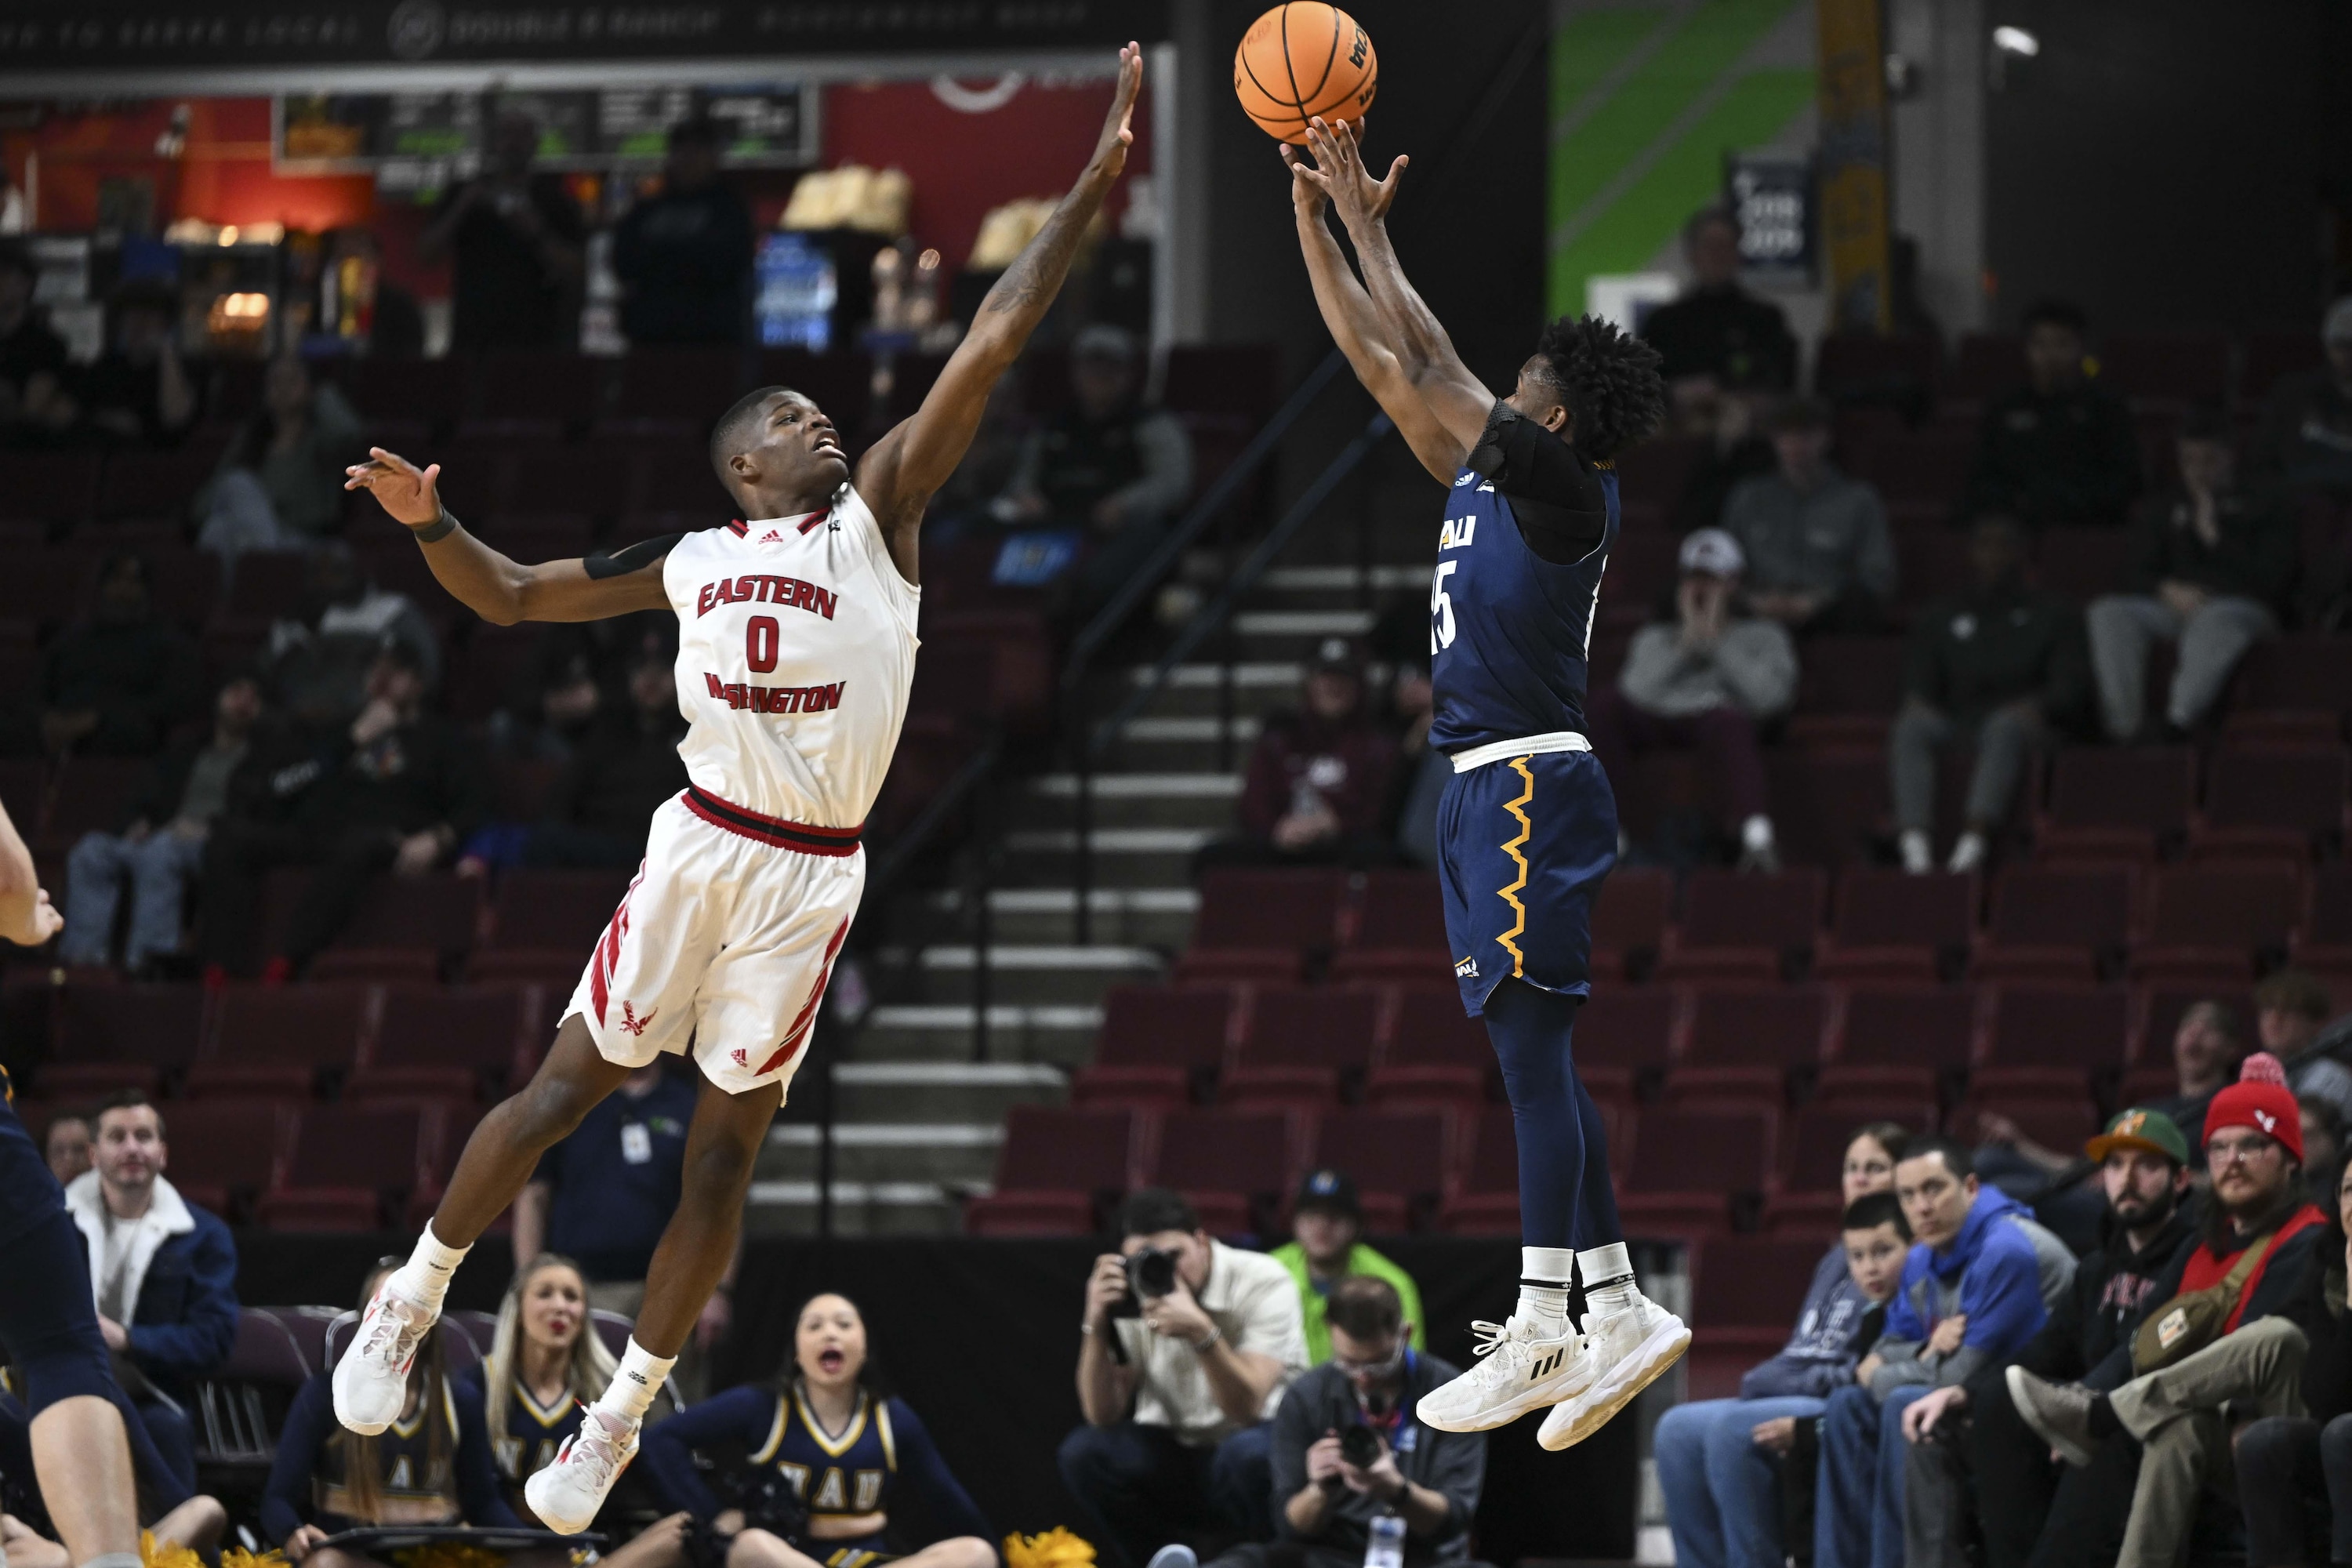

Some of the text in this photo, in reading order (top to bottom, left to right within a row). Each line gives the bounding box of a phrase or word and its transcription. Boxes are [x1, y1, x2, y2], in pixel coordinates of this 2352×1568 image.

[697, 575, 838, 621] EASTERN
[746, 615, 779, 673] 0
[703, 672, 847, 713] WSHINGTON
